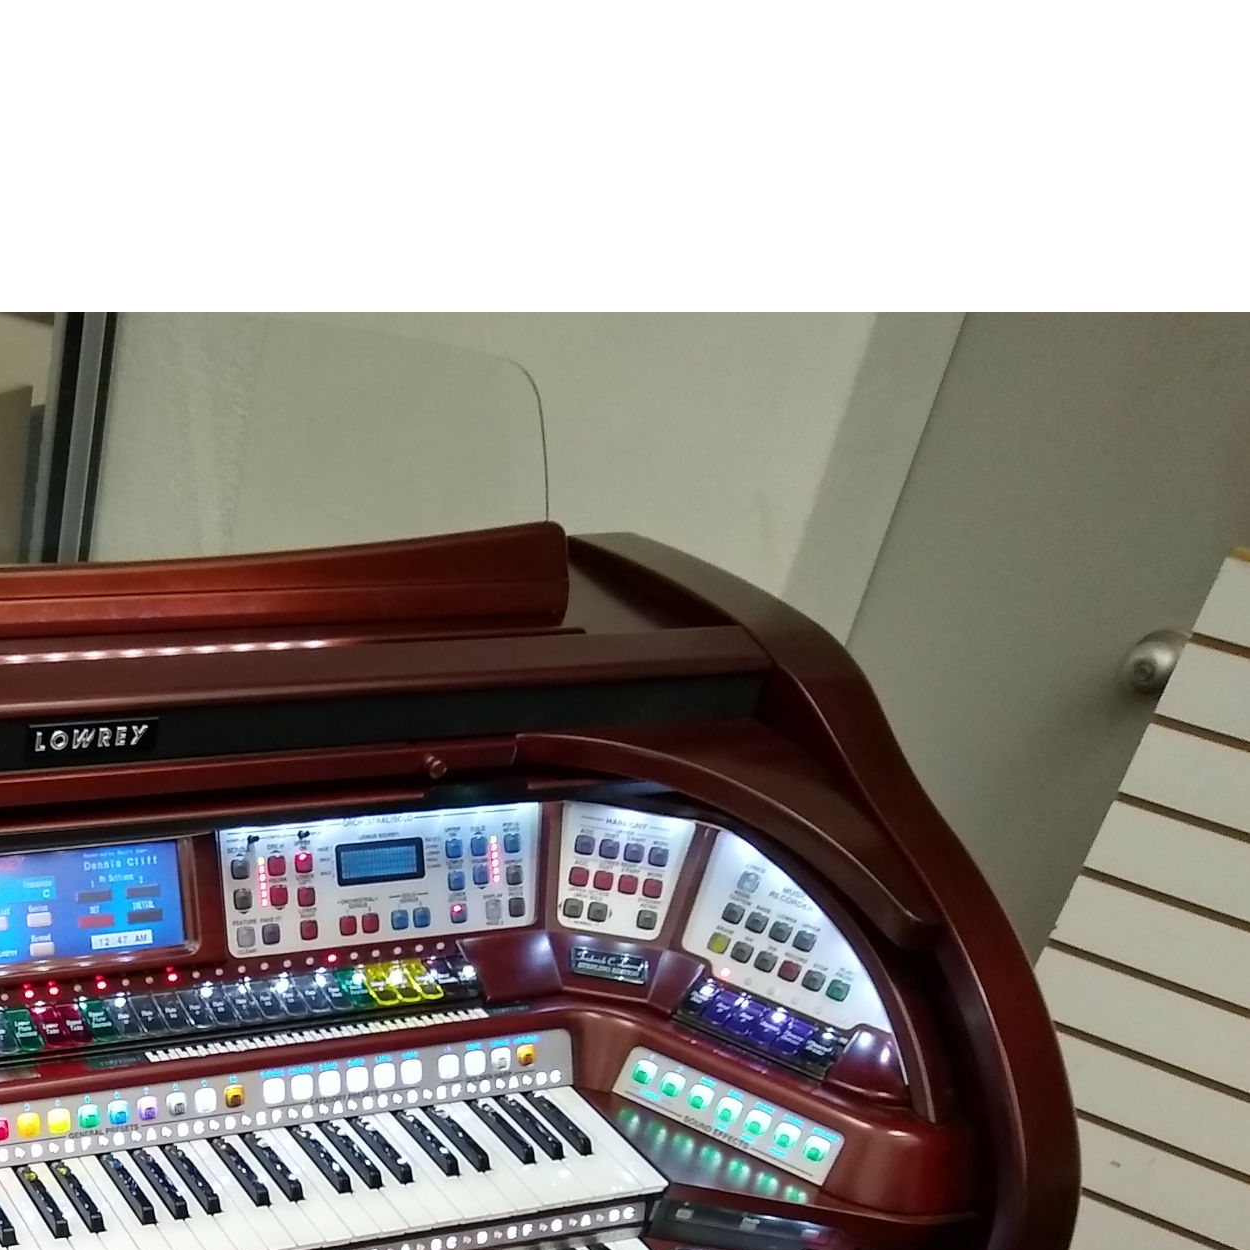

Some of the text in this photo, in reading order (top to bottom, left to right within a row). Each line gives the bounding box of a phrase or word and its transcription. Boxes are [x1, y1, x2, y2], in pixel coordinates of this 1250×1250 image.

[35, 725, 148, 751] LOWREY
[42, 888, 51, 898] C
[135, 934, 148, 942] AM
[68, 1124, 140, 1140] GENERAL PRESETS
[683, 1116, 749, 1150] SOUND EFFECTS
[446, 1236, 457, 1249] C
[522, 1223, 533, 1237] F
[580, 1214, 592, 1227] A
[622, 1206, 635, 1220] C
